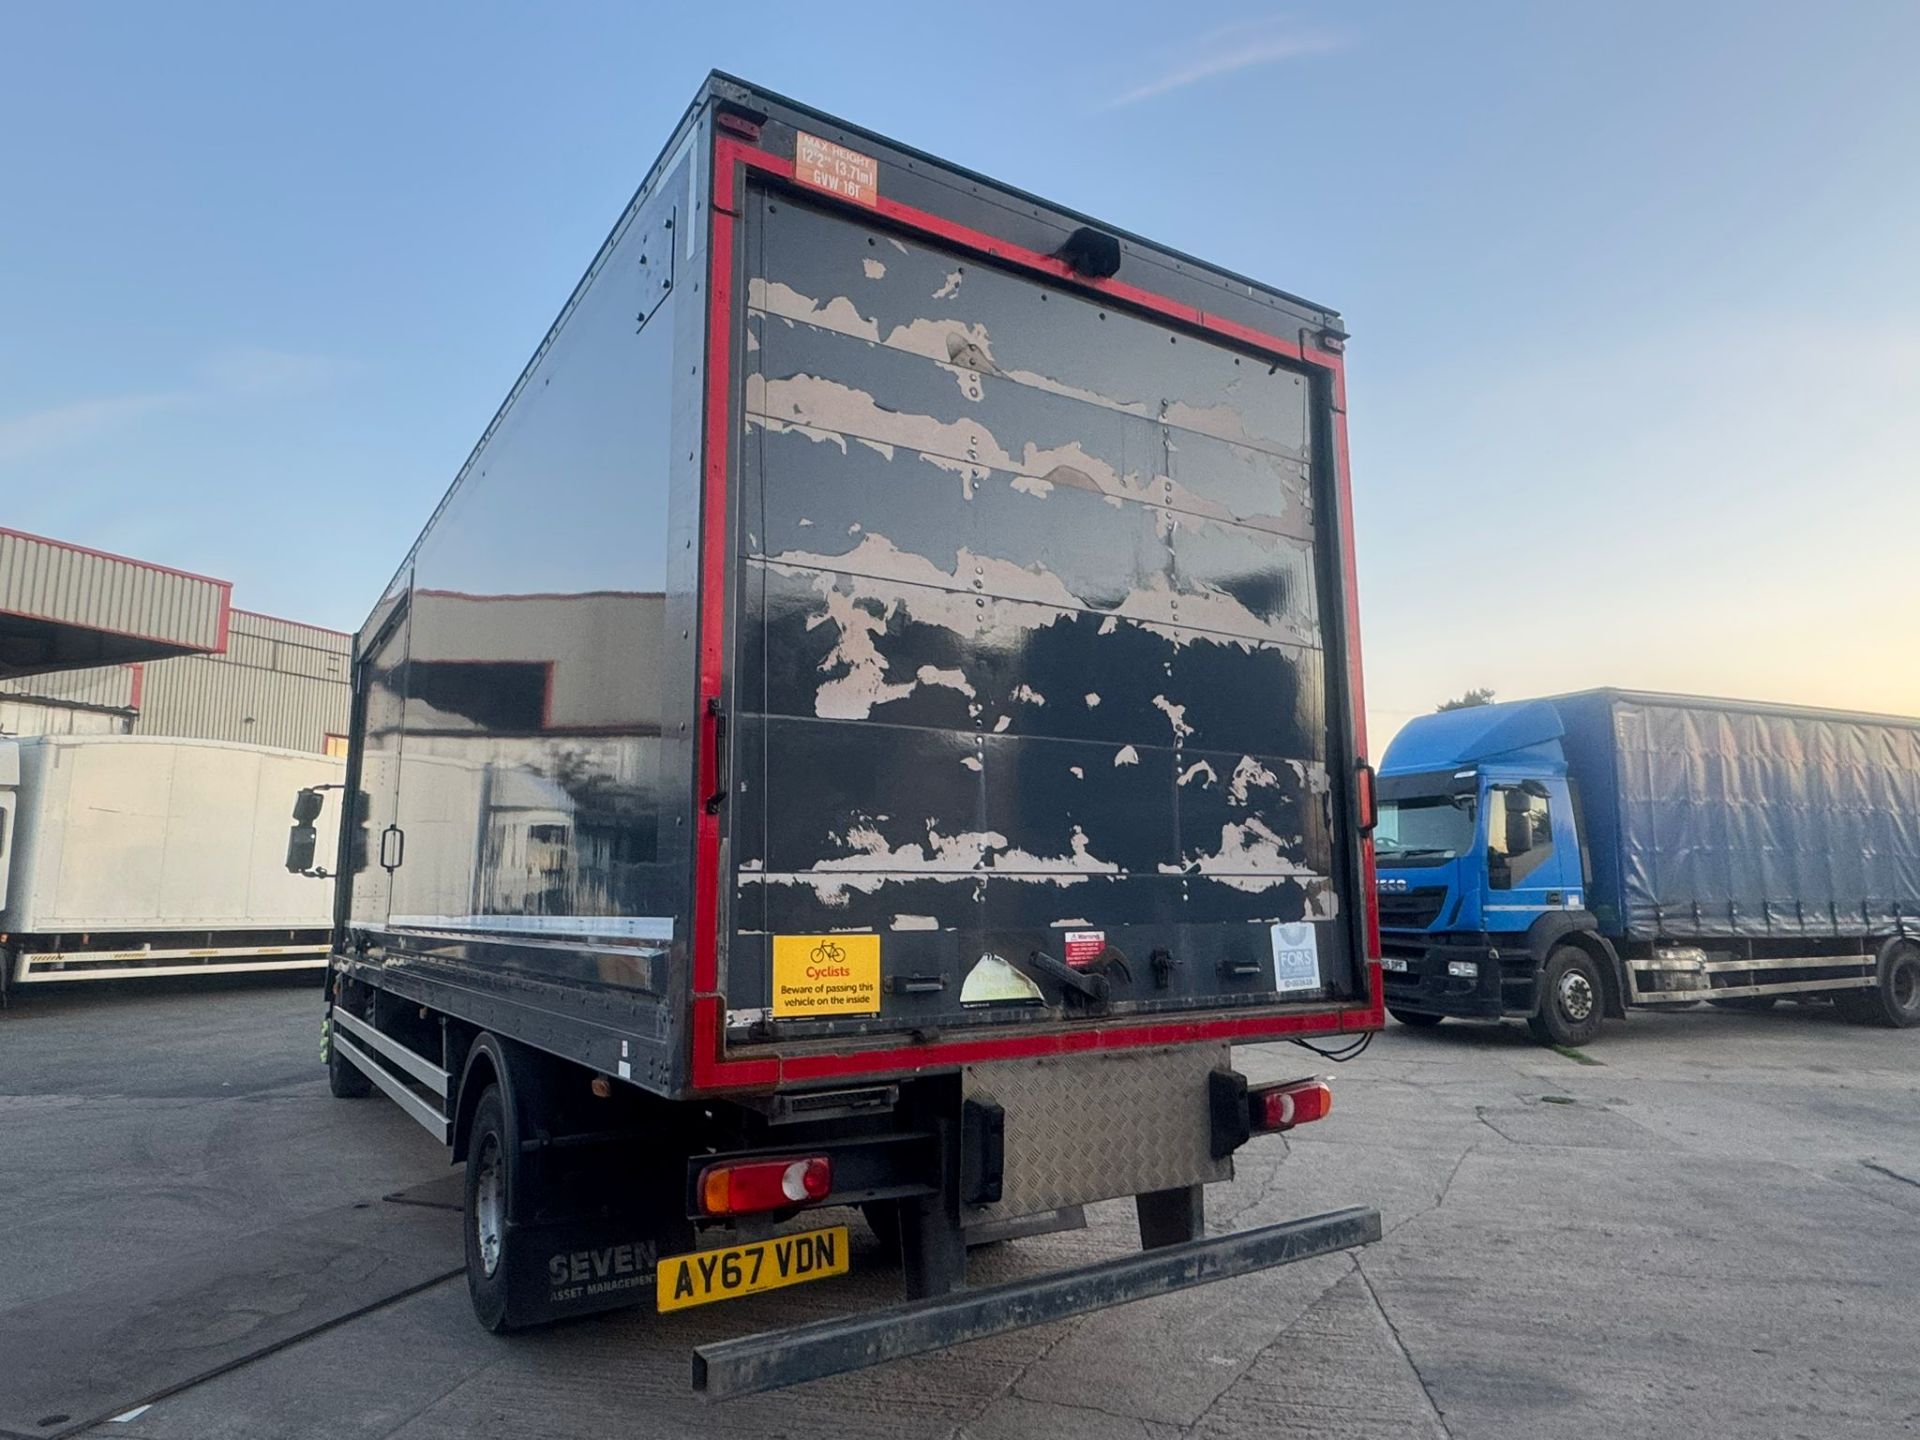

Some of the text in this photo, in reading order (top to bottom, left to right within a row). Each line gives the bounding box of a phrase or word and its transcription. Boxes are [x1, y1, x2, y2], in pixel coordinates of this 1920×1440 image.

[832, 143, 870, 168] HEIGHT
[814, 169, 861, 198] GVW 16T
[1376, 879, 1406, 891] ECO
[1281, 950, 1312, 967] FORS
[806, 966, 850, 980] Cyclists
[781, 982, 873, 994] Beware of passing this
[784, 997, 815, 1006] vehicle
[830, 996, 844, 1005] the
[846, 995, 870, 1004] inside
[549, 1240, 656, 1285] SEVEN
[674, 1232, 835, 1300] AY67 VDN
[550, 1273, 656, 1302] ASSET MANAGEMENT
